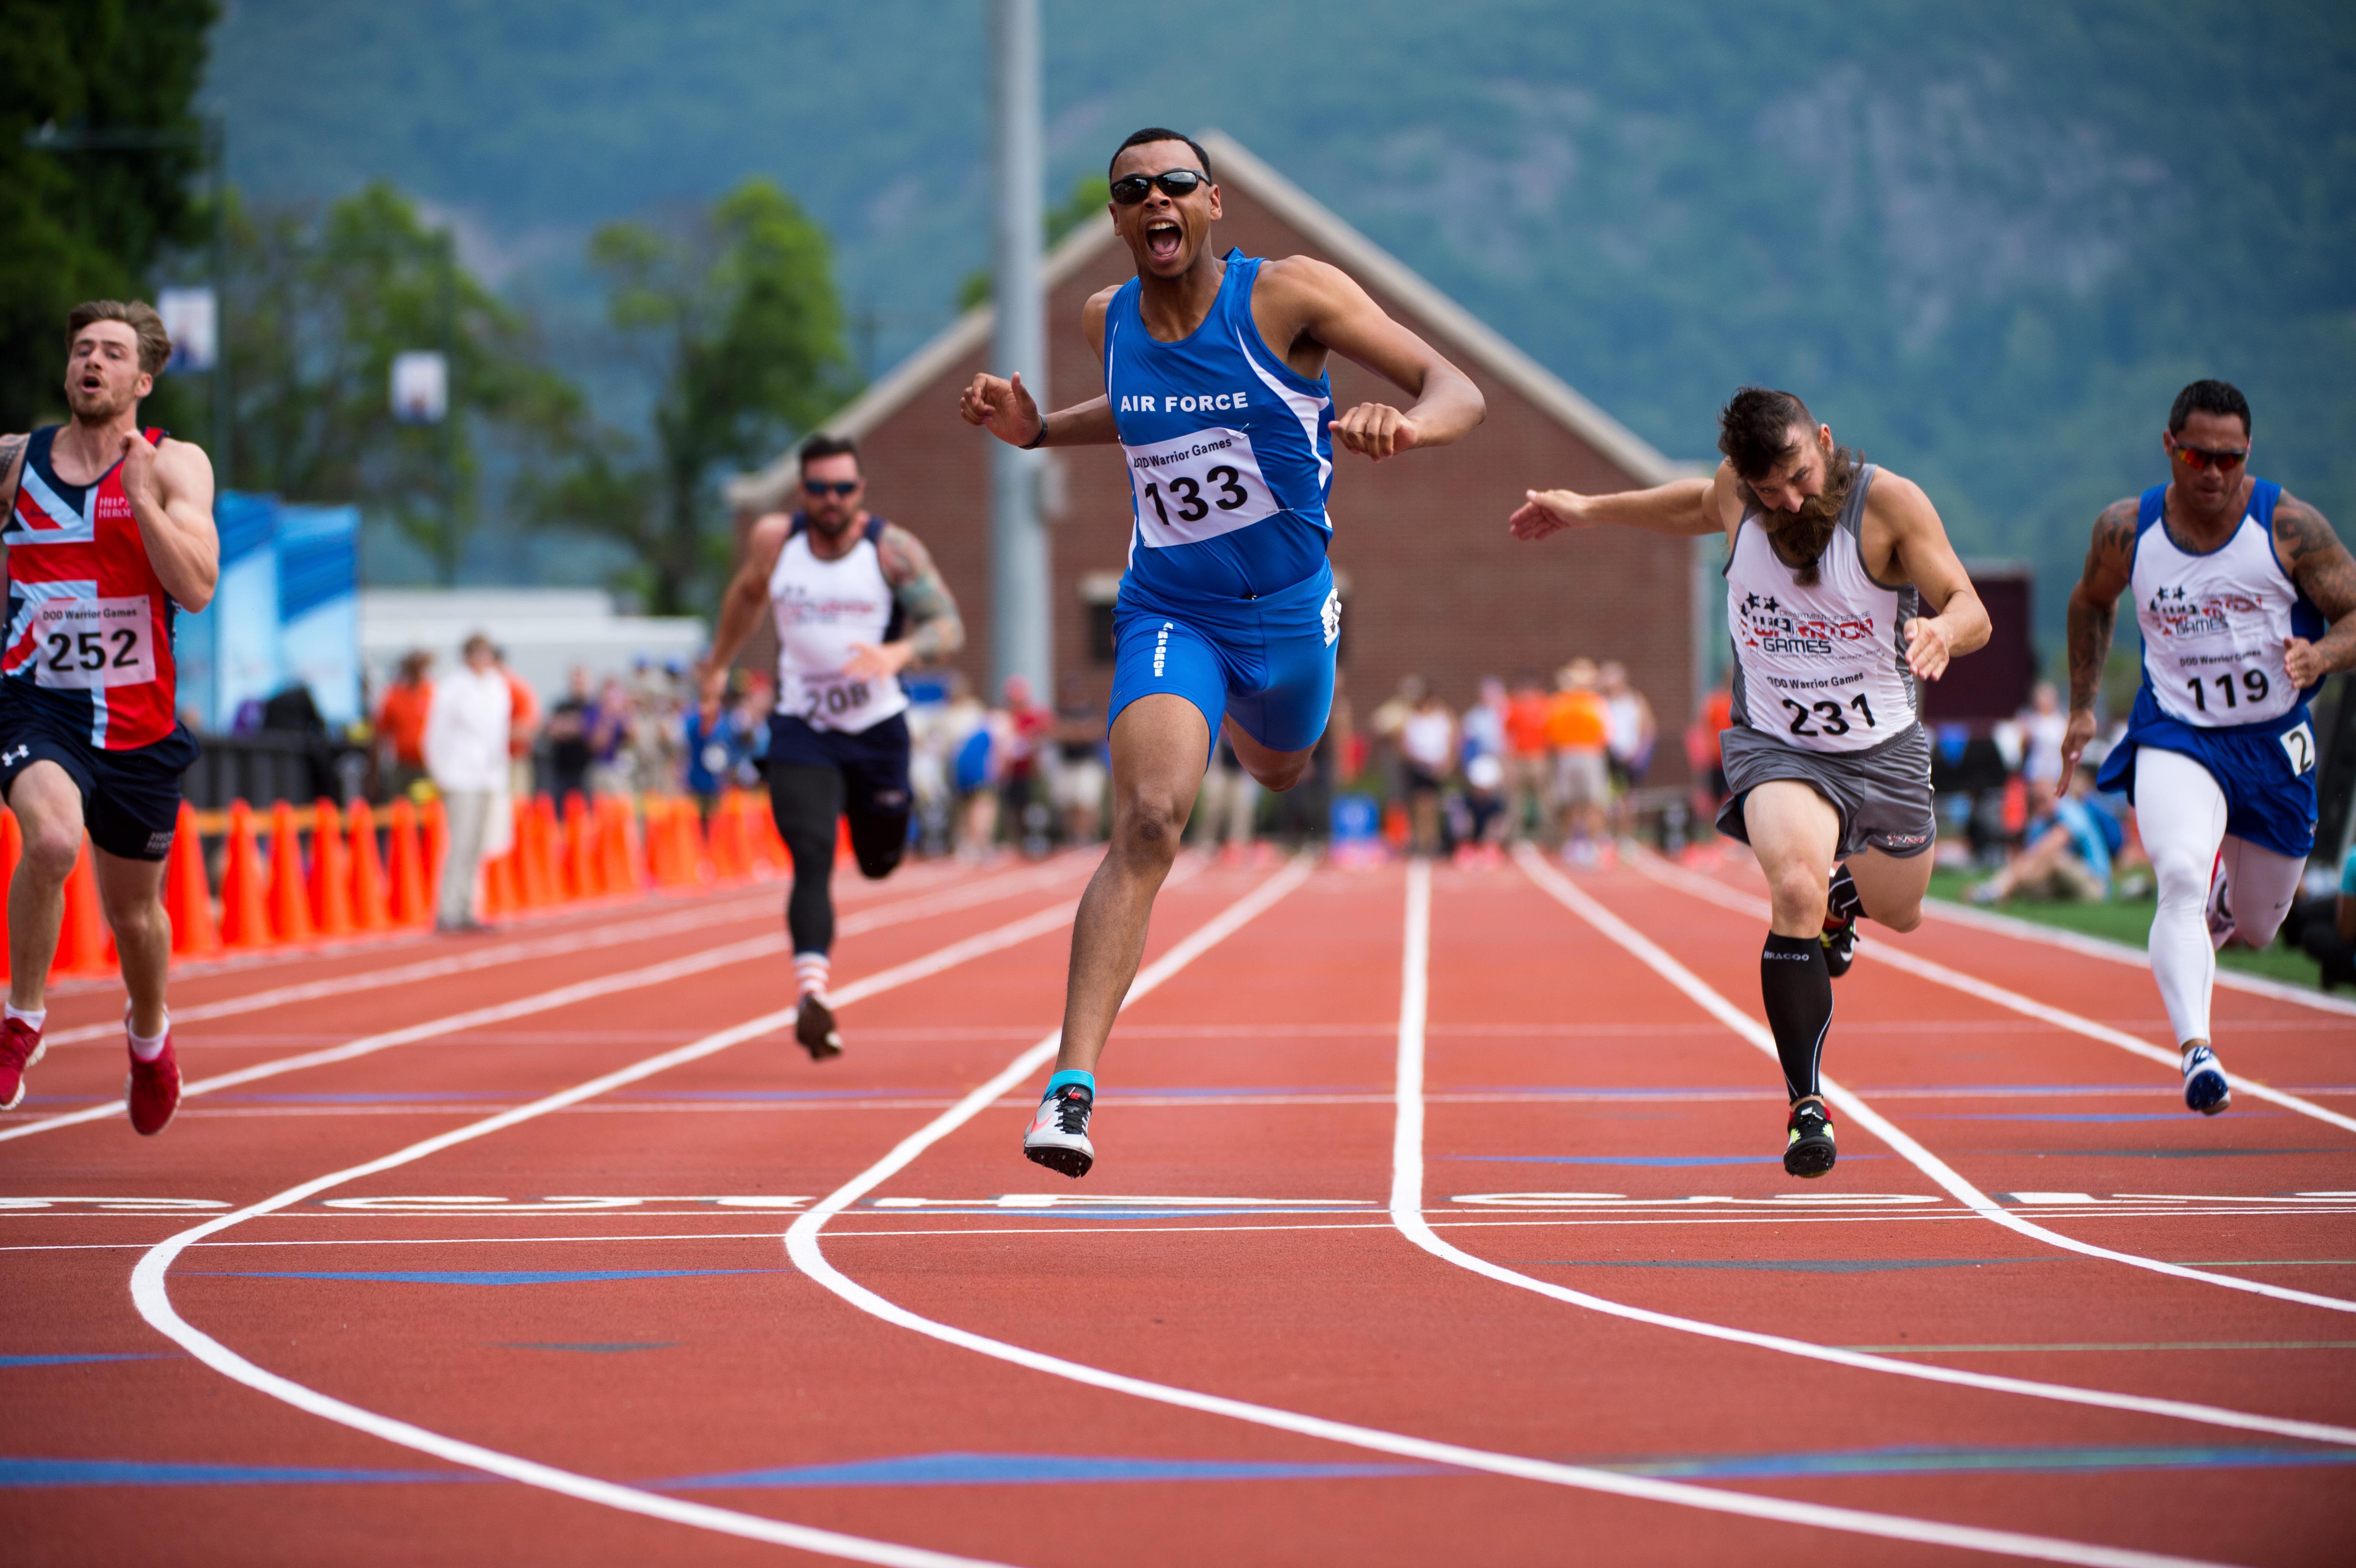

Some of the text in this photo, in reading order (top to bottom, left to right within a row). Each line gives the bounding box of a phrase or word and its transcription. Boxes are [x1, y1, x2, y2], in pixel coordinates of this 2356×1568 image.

[1121, 392, 1248, 413] AIR FORCE
[1150, 450, 1189, 466] Warrior
[1192, 438, 1232, 456] Games
[99, 496, 125, 507] HELP
[1145, 465, 1248, 525] 133
[43, 608, 137, 620] DOD Warrior Games
[1779, 610, 1827, 621] DEPARTMENT
[1753, 616, 1876, 641] WARRIOR
[48, 629, 139, 671] 252
[1763, 638, 1831, 654] GAMES
[2180, 657, 2198, 666] DOD
[2200, 655, 2233, 664] Warrior
[1789, 679, 1829, 689] Warrior
[1831, 673, 1864, 686] Games
[2187, 669, 2269, 711] 119
[1782, 693, 1875, 737] 231
[2289, 731, 2312, 773] 2
[1764, 950, 1809, 961] BRACOO
